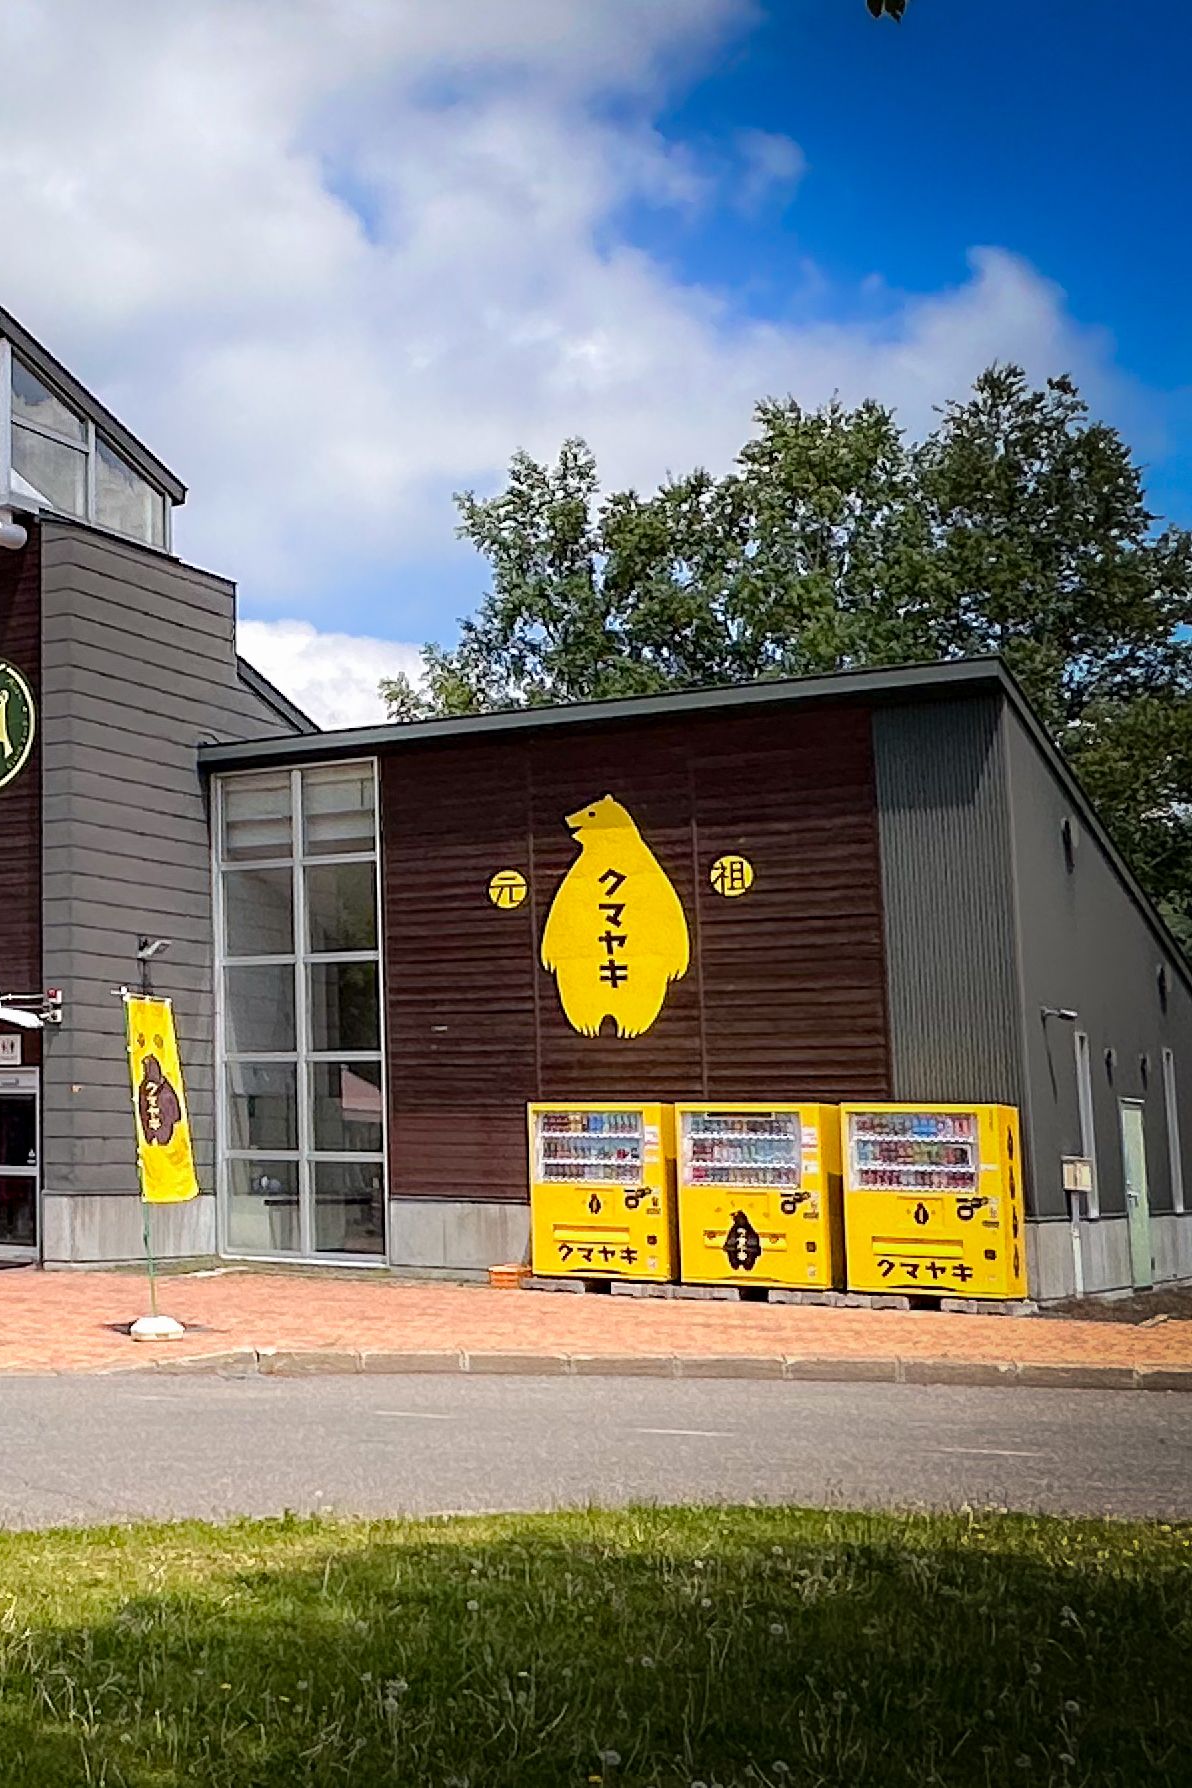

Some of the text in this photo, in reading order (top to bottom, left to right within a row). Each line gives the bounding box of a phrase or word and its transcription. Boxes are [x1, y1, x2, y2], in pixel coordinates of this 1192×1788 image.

[489, 860, 748, 908] 元 祖
[597, 867, 629, 989] クマヤキ
[557, 1243, 639, 1266] クマヤキ
[876, 1258, 975, 1284] クマヤキ
